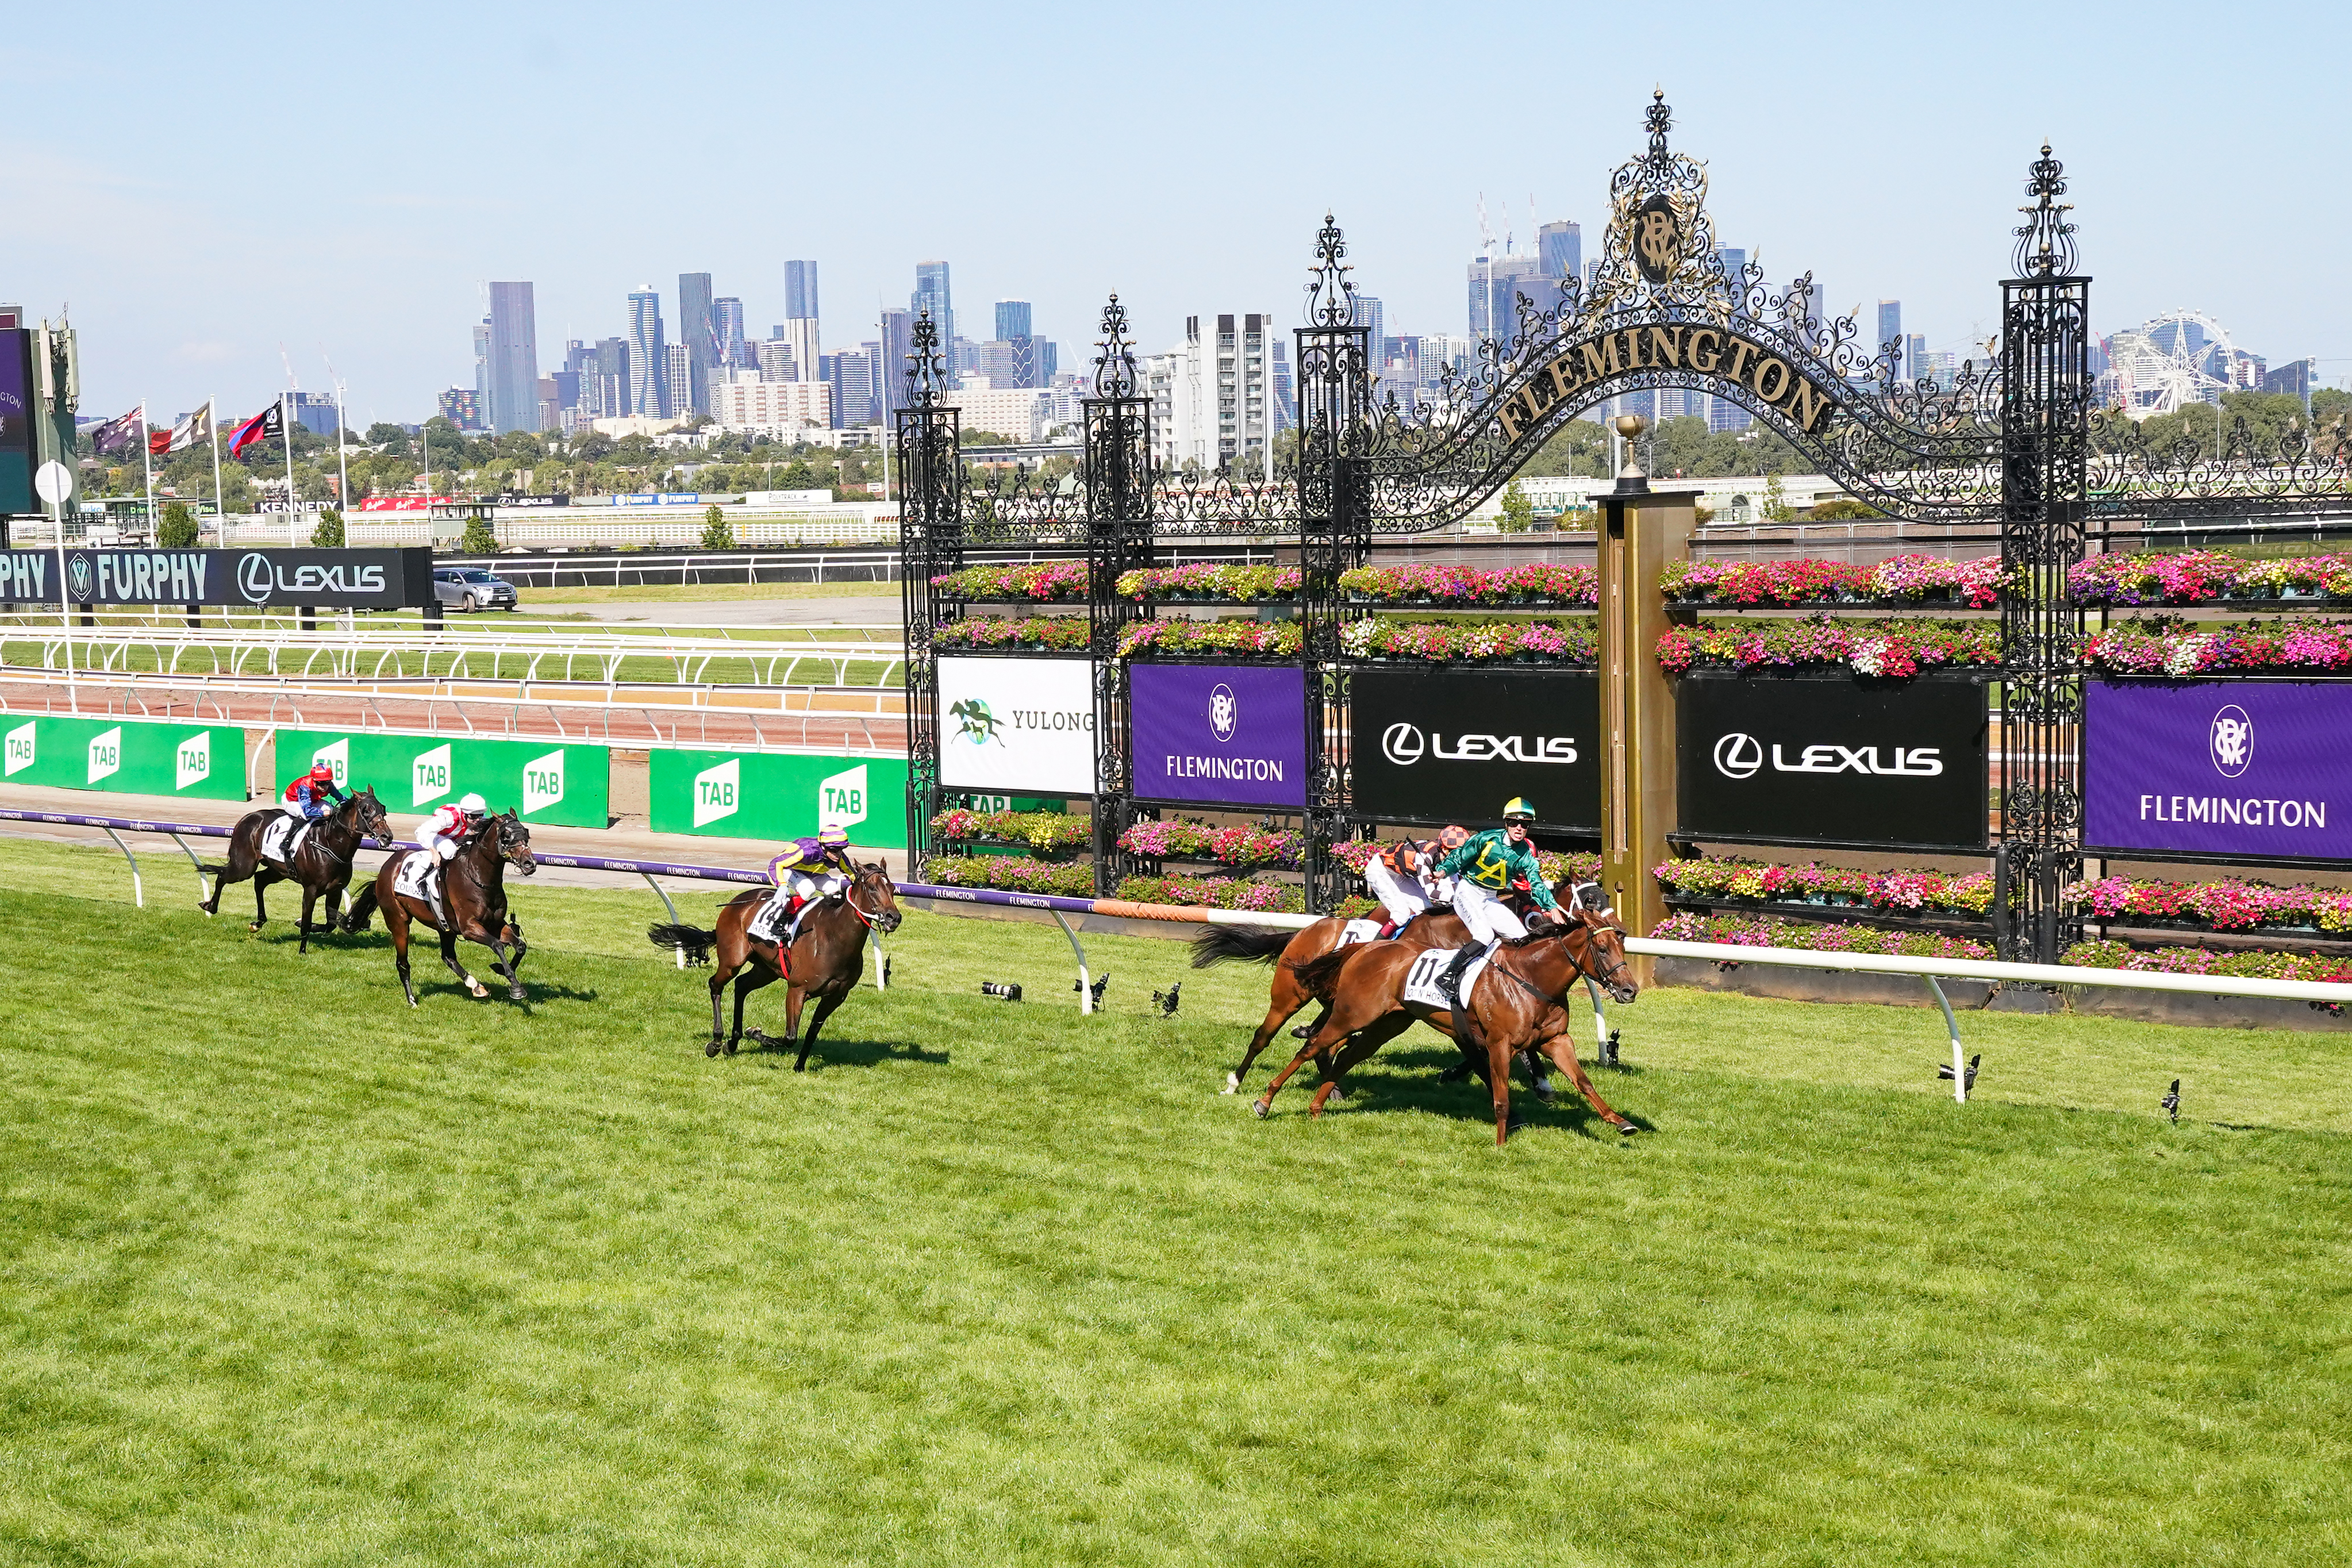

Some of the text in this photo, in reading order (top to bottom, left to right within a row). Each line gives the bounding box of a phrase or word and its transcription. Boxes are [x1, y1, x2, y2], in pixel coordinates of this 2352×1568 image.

[1494, 326, 1832, 445] FLEMINGTON
[260, 501, 338, 513] KENNEDY
[97, 554, 207, 600] FURPHY
[276, 566, 386, 592] LEXUS
[1013, 710, 1094, 732] YULONG
[9, 739, 31, 759] TAB
[93, 745, 116, 766] TAB
[1432, 733, 1578, 763] LEXUS
[1772, 744, 1943, 776] LEXUS
[181, 751, 206, 772] TAB
[1167, 755, 1283, 782] FLEMINGTON
[417, 764, 446, 787] TAB
[528, 771, 559, 795] TAB
[700, 781, 733, 806] TAB
[824, 787, 862, 814] TAB
[2140, 794, 2326, 828] FLEMINGTON
[402, 861, 416, 882] 4
[545, 857, 763, 883] FLEMINGTON FLEMINGTON FLEMINGTON FLEMINGTON
[936, 889, 1051, 908] FLEMINGTON FLEMINGTON
[758, 901, 785, 926] 14
[1411, 957, 1439, 987] 11
[1427, 991, 1449, 1005] HORSE
